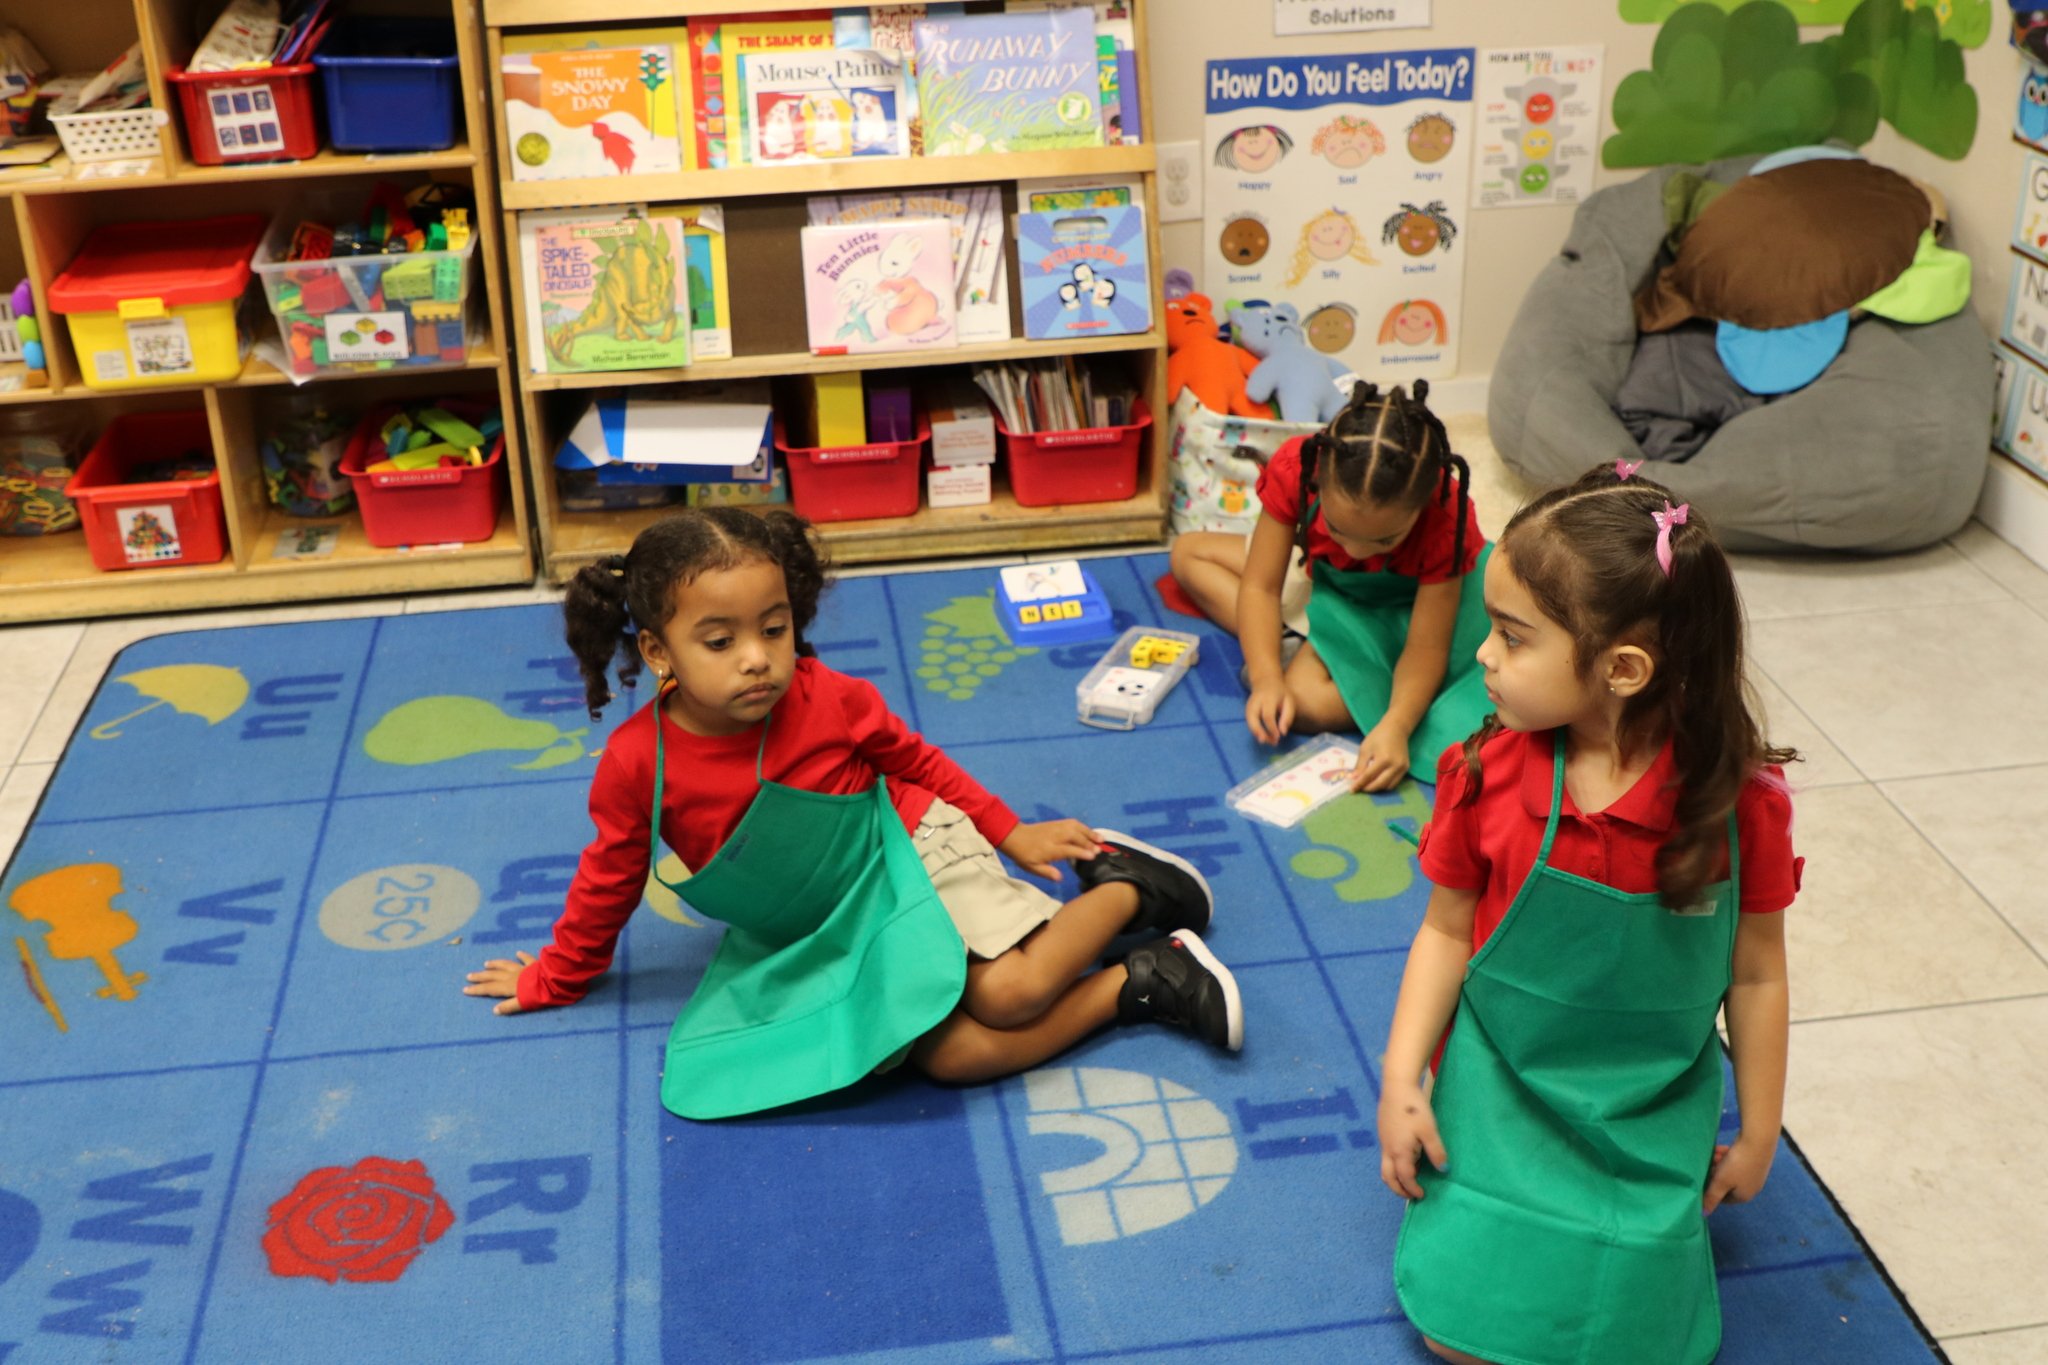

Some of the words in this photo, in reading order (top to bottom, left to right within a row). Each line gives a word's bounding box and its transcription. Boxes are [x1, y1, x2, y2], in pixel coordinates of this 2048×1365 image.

[1310, 8, 1396, 26] Solutions
[738, 36, 761, 48] THE
[765, 35, 804, 47] SHAPE
[808, 35, 825, 46] OF
[923, 31, 1072, 66] RUNAWAY
[571, 67, 605, 79] THE
[757, 62, 826, 82] Mouse
[980, 62, 1092, 94] BUNNY
[1210, 67, 1262, 100] How
[1266, 65, 1299, 98] Do
[1302, 64, 1341, 97] You
[1345, 58, 1390, 94] Feel
[1394, 56, 1470, 97] Today?
[551, 77, 629, 97] SNOWY
[571, 95, 612, 112] DAY
[1338, 175, 1358, 185] Sad
[1413, 171, 1443, 182] Angry
[1238, 181, 1271, 191] Happy
[841, 198, 902, 223] MAPLE
[907, 196, 969, 215] SYRUP
[838, 231, 879, 253] Little
[543, 262, 591, 280] TAILED
[816, 253, 839, 276] Ten
[828, 242, 880, 282] Bunnies
[1402, 263, 1436, 274] Excited
[1228, 273, 1261, 284] Scared
[1322, 269, 1341, 280] Silly
[543, 279, 592, 292] DINOSAUR
[1381, 353, 1441, 366] Embarrassed
[1054, 432, 1114, 444] SCHOLASTIC
[829, 448, 891, 460] SCHOLASTIC
[388, 472, 452, 484] SCHOLASTIC
[240, 673, 344, 741] Uu
[162, 877, 285, 966] Vv
[461, 1152, 593, 1266] Rr
[36, 1152, 214, 1341] Ww
